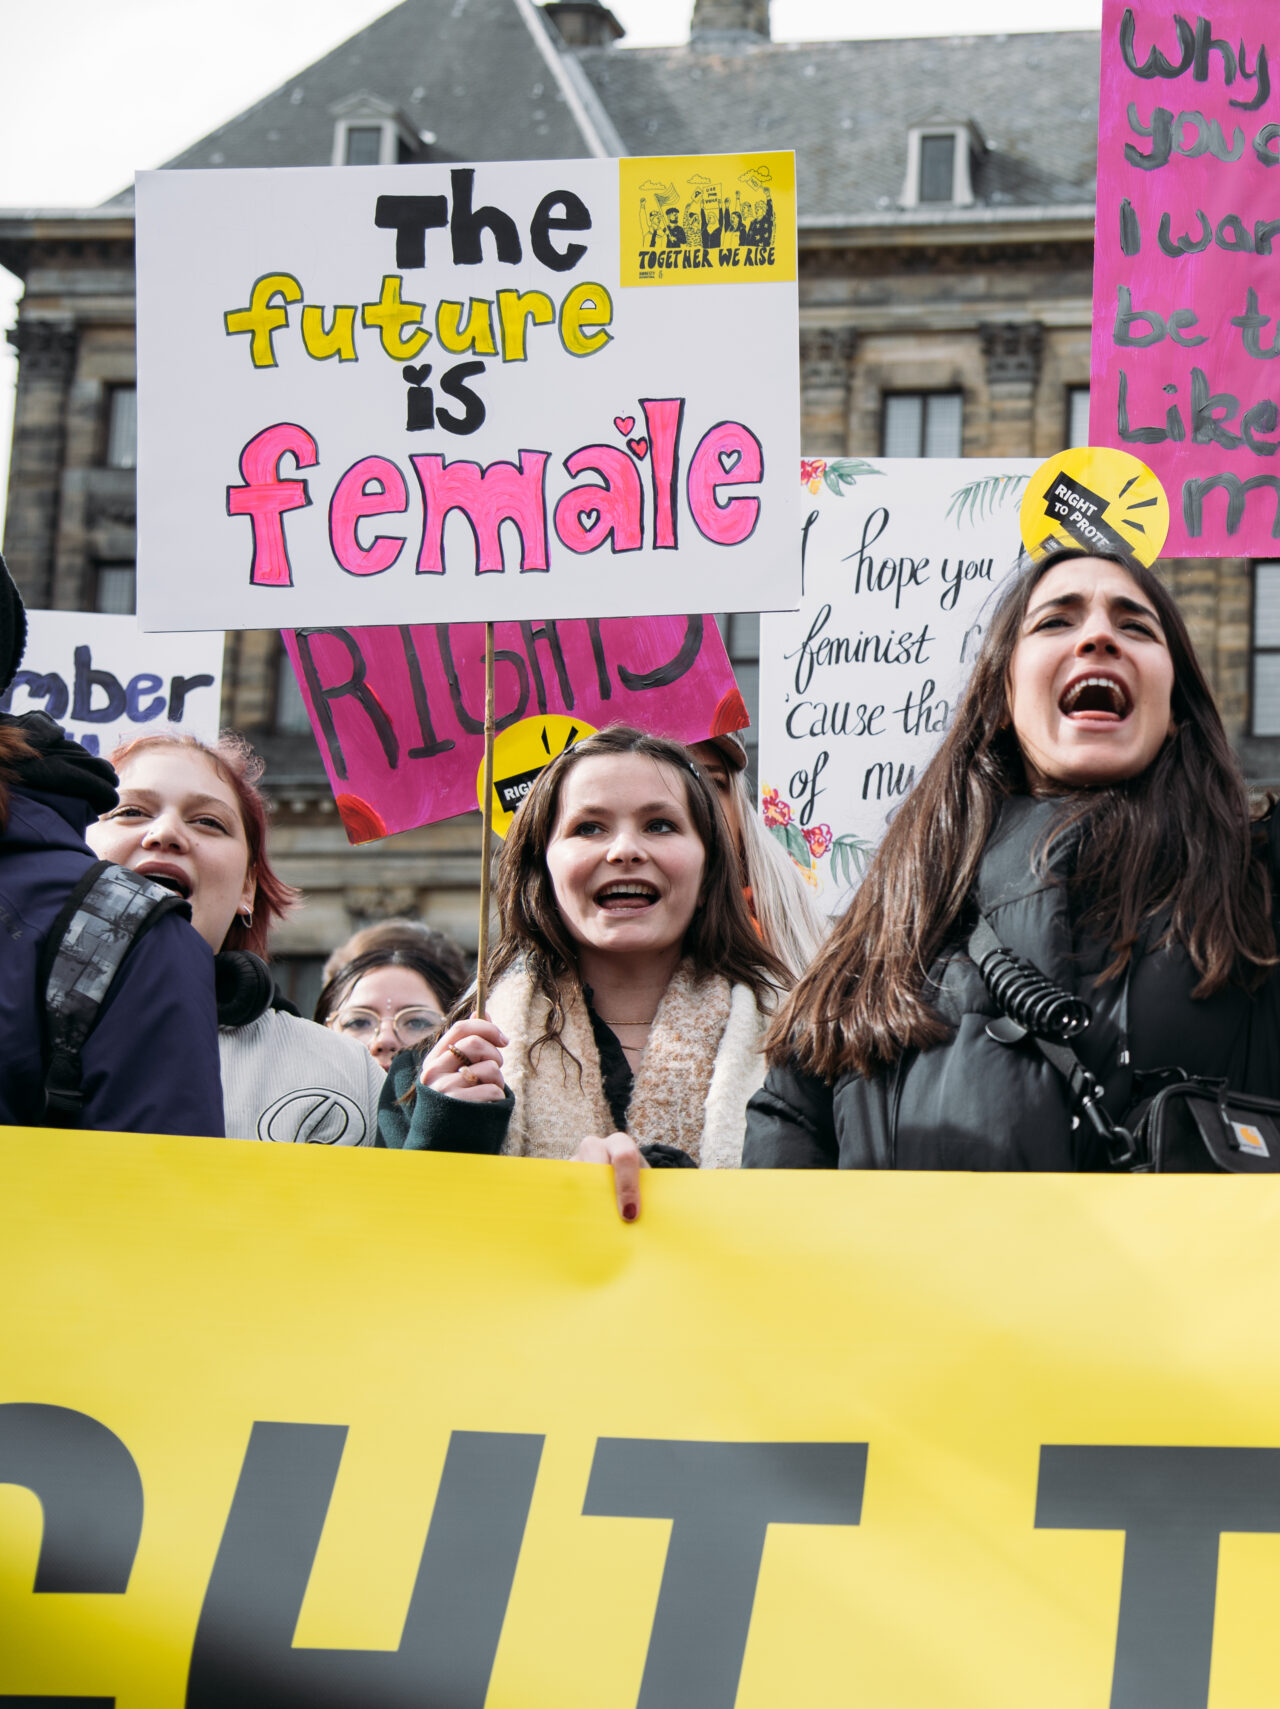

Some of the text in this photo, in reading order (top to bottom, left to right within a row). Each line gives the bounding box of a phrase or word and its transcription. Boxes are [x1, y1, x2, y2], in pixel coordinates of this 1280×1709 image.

[1119, 8, 1271, 111] Why
[1124, 101, 1246, 171] you
[375, 168, 592, 272] The
[638, 246, 776, 269] TOGETHER WE RISE
[1119, 198, 1141, 256] I
[224, 271, 614, 368] future
[1113, 284, 1209, 348] be
[402, 360, 487, 435] is
[225, 398, 766, 588] female
[1054, 484, 1098, 517] RIGHT
[1055, 502, 1069, 516] TO
[1069, 511, 1110, 548] PROTE
[842, 507, 930, 608] hope
[941, 557, 998, 610] you
[784, 604, 936, 695] feminist
[789, 751, 830, 826] of
